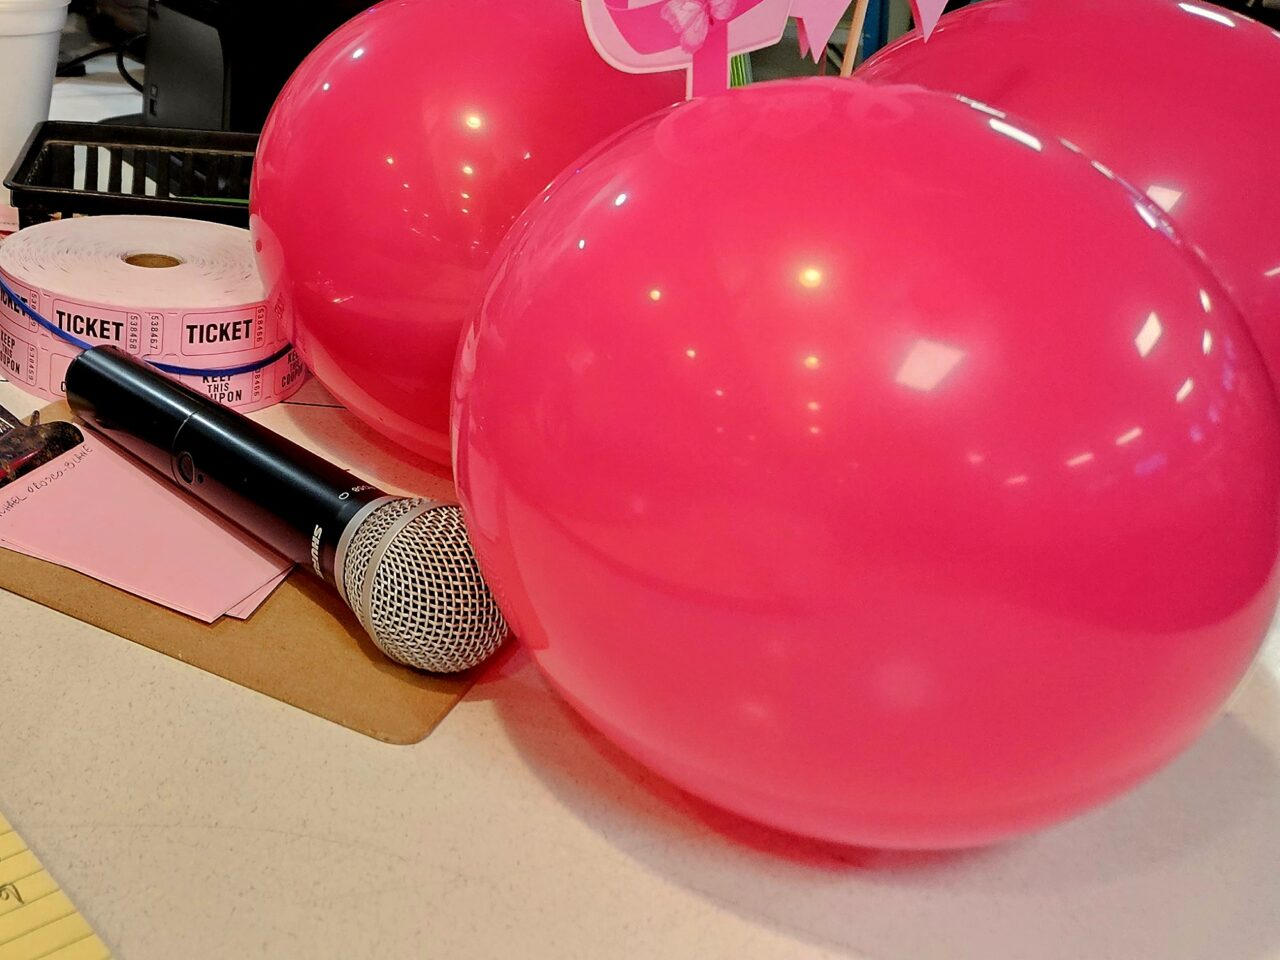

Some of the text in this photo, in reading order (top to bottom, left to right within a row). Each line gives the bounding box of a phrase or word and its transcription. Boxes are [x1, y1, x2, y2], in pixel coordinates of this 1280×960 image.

[0, 329, 16, 348] KEEP
[56, 309, 124, 341] TICKET
[129, 315, 138, 350] 538458
[150, 315, 159, 350] 538467
[186, 318, 254, 344] TICKET
[255, 307, 265, 343] 538466
[1, 342, 14, 359] THIS
[28, 346, 36, 381] 538459
[207, 382, 231, 394] THIS
[209, 389, 243, 404] UPON
